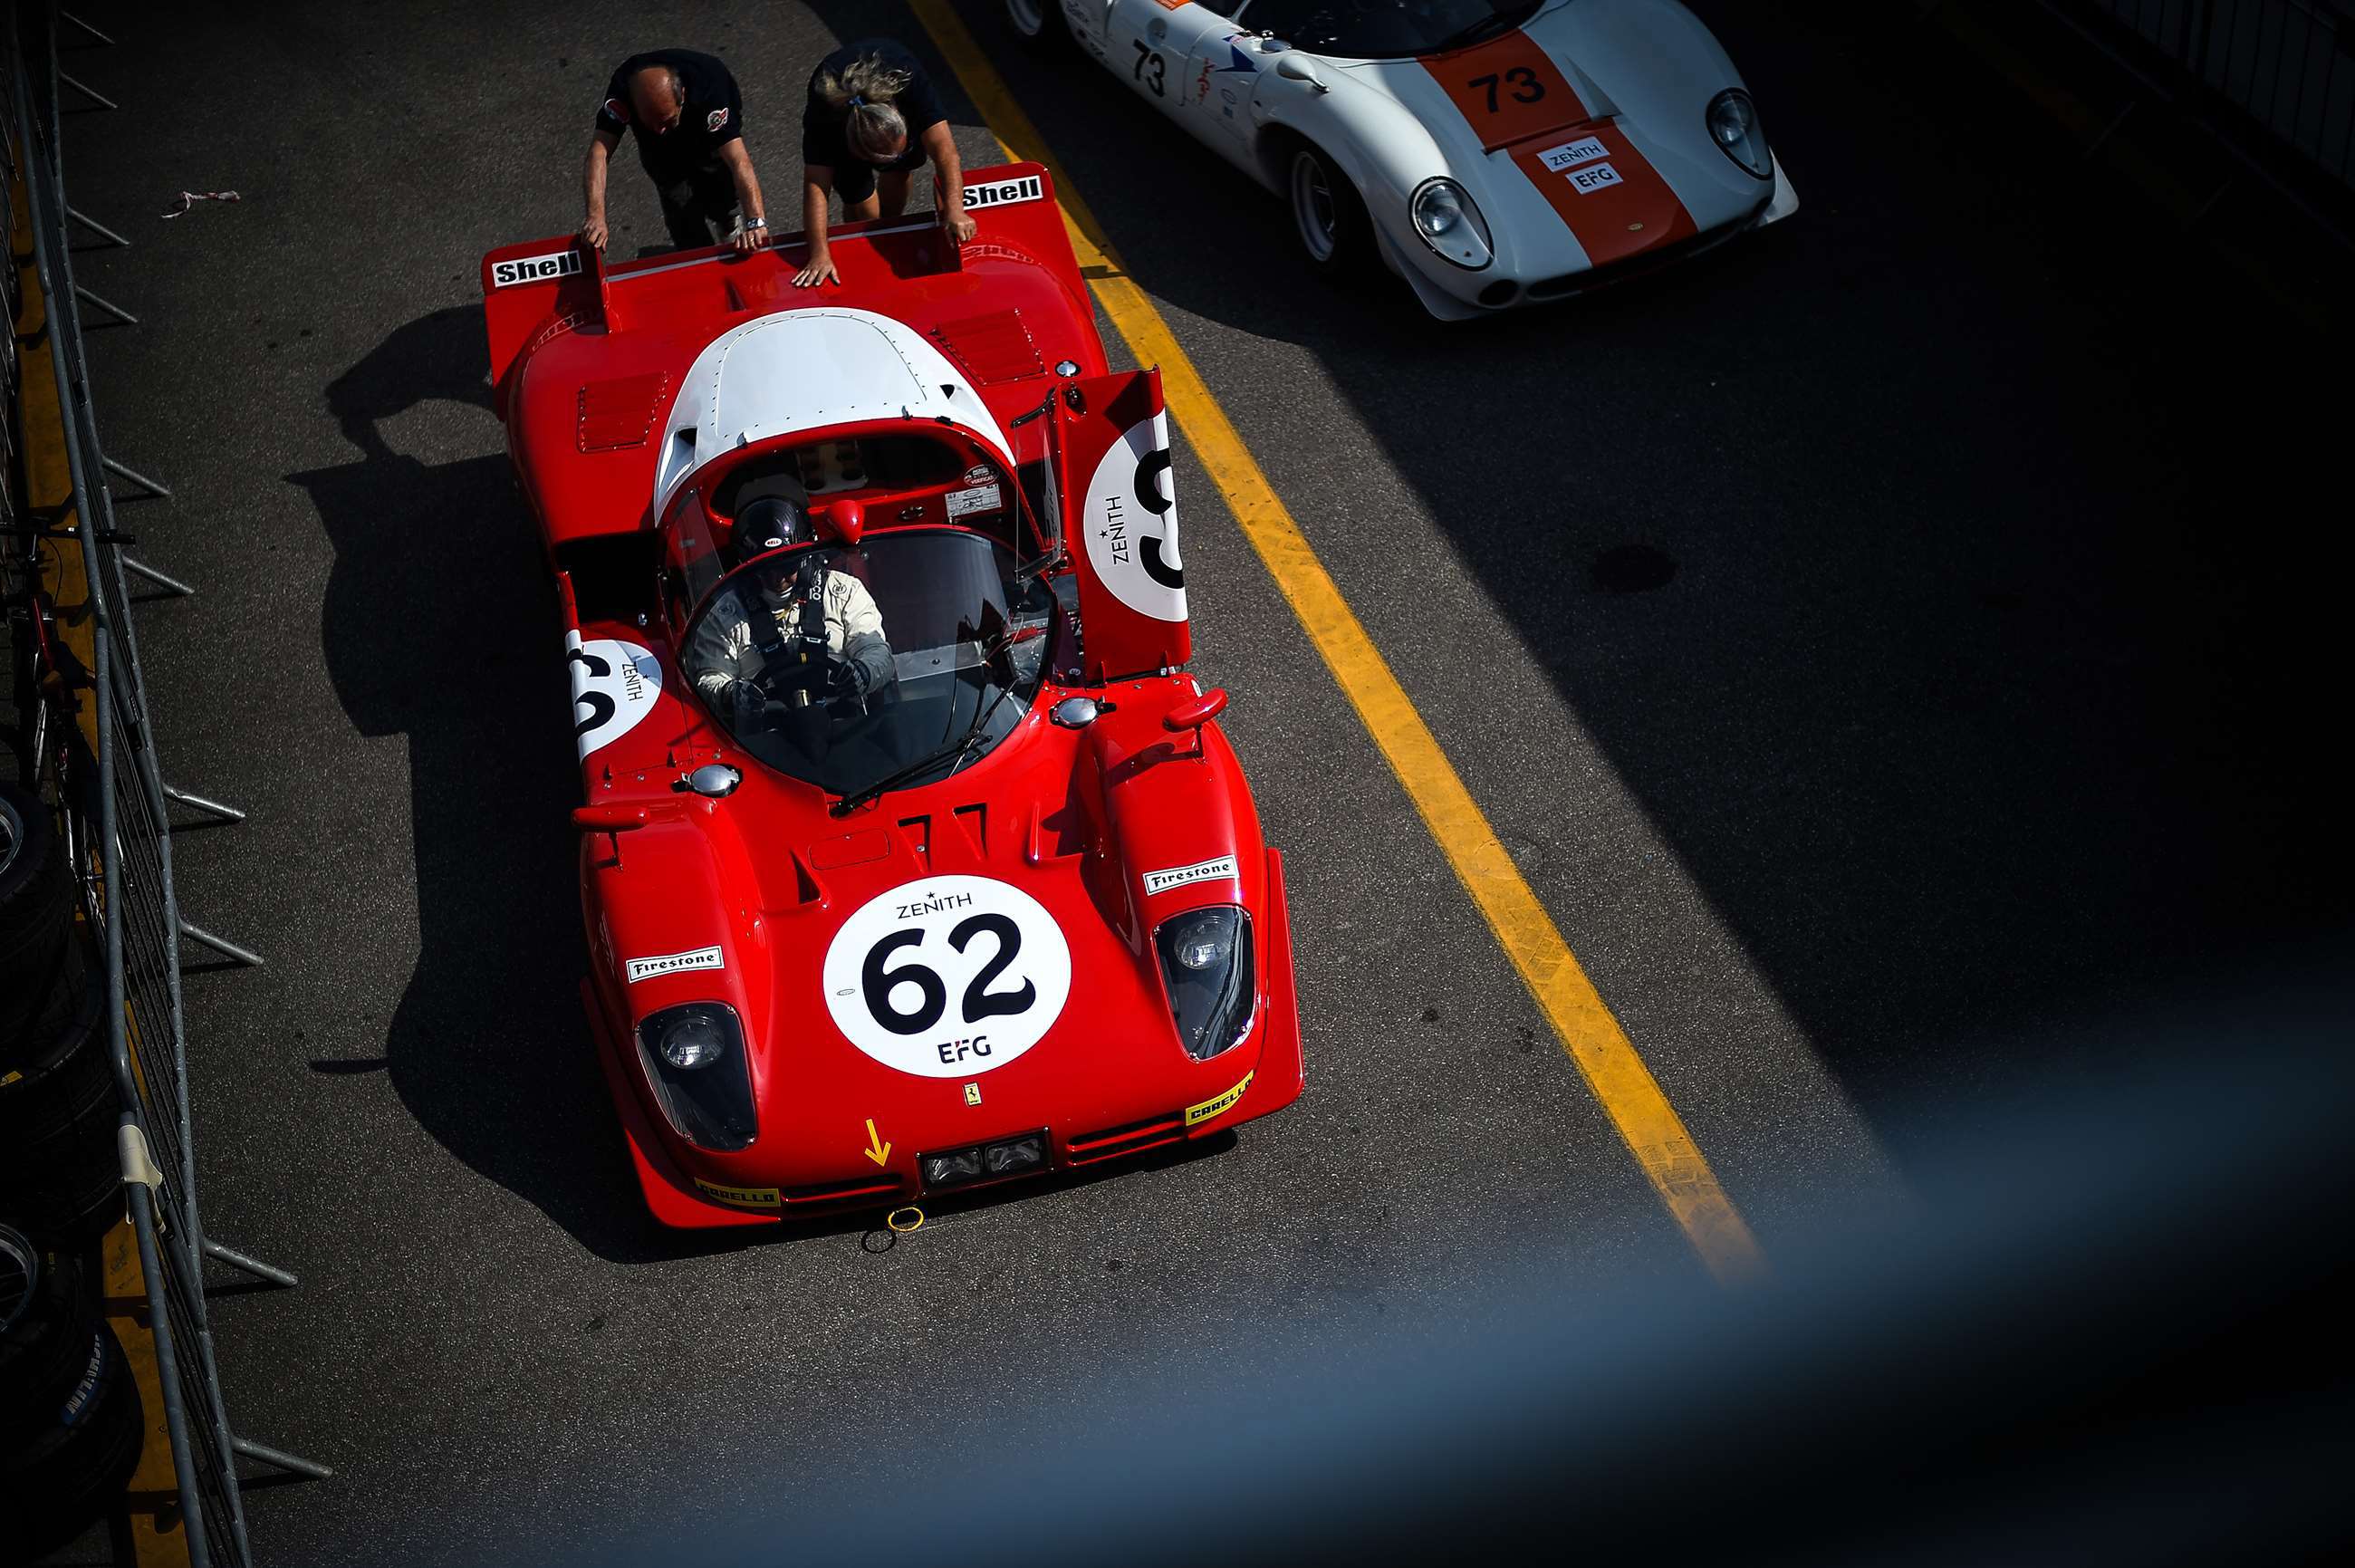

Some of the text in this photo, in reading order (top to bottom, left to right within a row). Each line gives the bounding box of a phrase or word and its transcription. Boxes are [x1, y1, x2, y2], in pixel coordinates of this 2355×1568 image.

[1134, 39, 1165, 98] 73
[1467, 67, 1545, 113] 73
[1548, 144, 1602, 167] ZENITH
[963, 178, 1040, 207] Shell
[1575, 168, 1614, 188] EFG
[495, 251, 582, 284] Shell
[1105, 495, 1129, 565] ZENITH
[621, 661, 644, 702] ZENITH
[1151, 863, 1230, 889] Firestone
[896, 892, 973, 919] ZENITH
[633, 954, 715, 976] Firestone
[861, 913, 1036, 1035] 62
[937, 1035, 992, 1064] EFG
[1190, 1078, 1251, 1120] CARELLO
